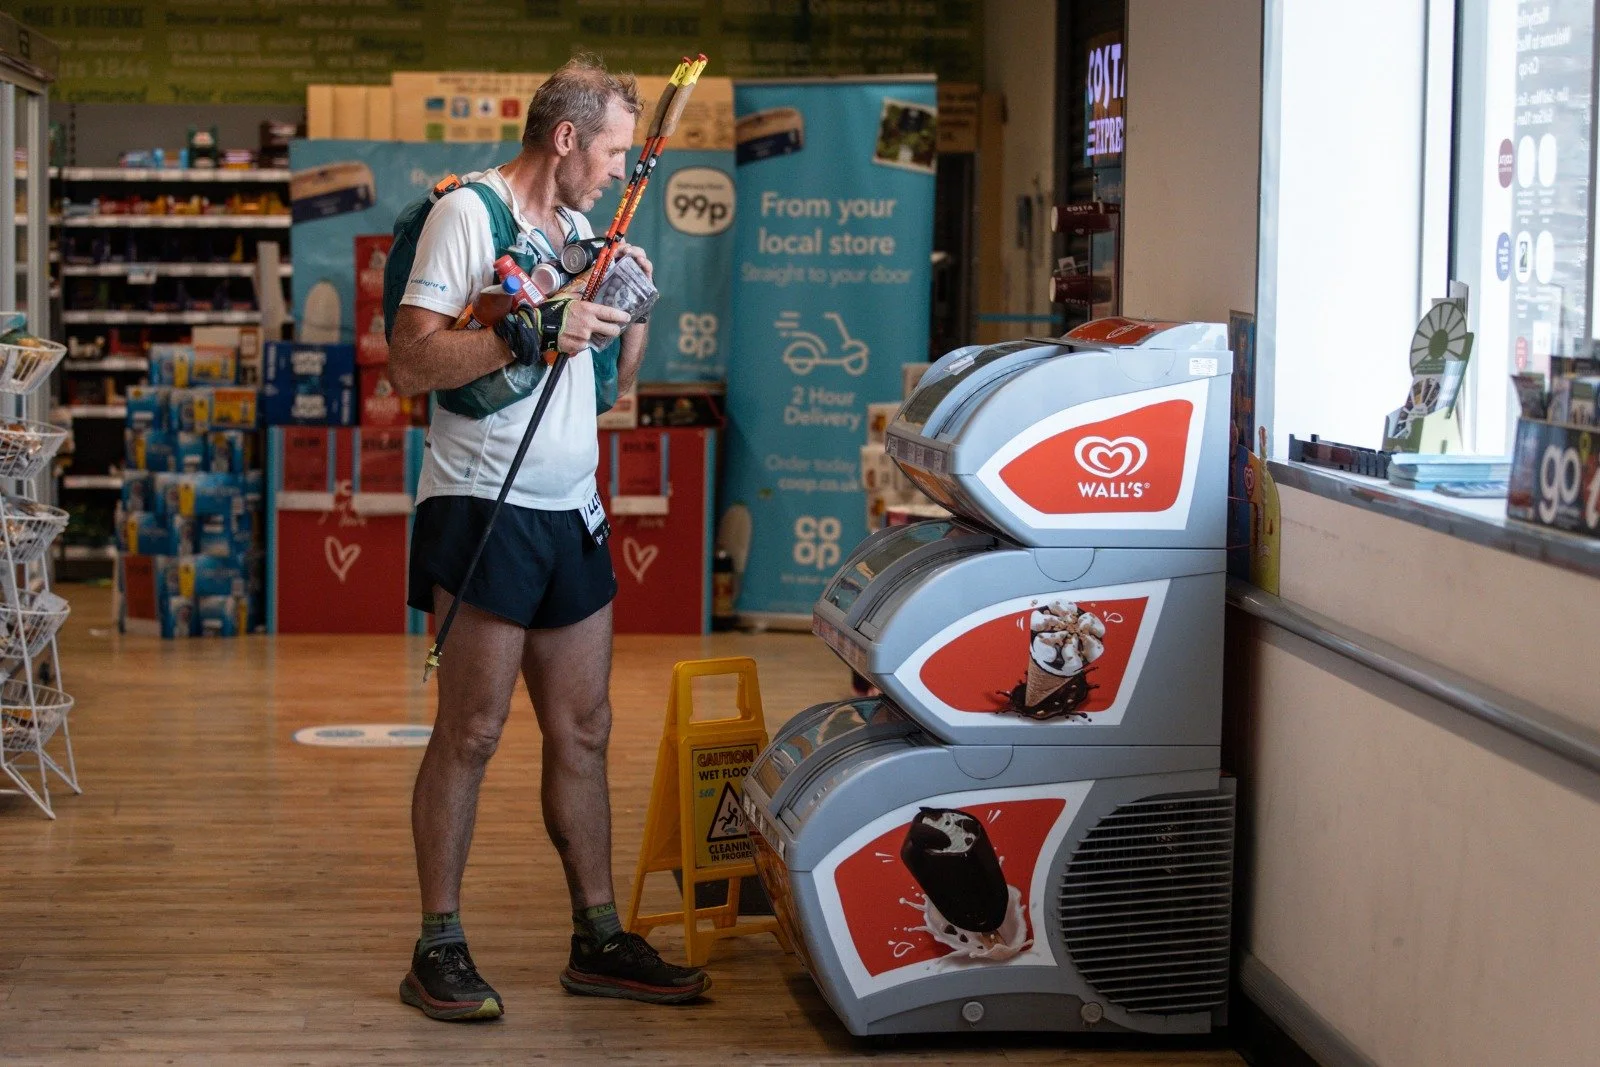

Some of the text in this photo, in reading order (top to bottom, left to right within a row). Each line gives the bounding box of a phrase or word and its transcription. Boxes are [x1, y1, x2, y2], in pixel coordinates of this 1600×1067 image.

[674, 194, 728, 227] 99p
[761, 192, 898, 226] From your
[758, 228, 895, 256] local store
[742, 264, 912, 290] Straight to your door
[791, 387, 855, 406] 2 Hour
[784, 405, 861, 431] Delivery
[1077, 482, 1144, 498] WALL'S
[697, 749, 754, 768] CAUTION
[699, 766, 751, 781] WET FLOO
[709, 841, 751, 855] CLEANIN
[711, 850, 753, 862] IN PROGRES
